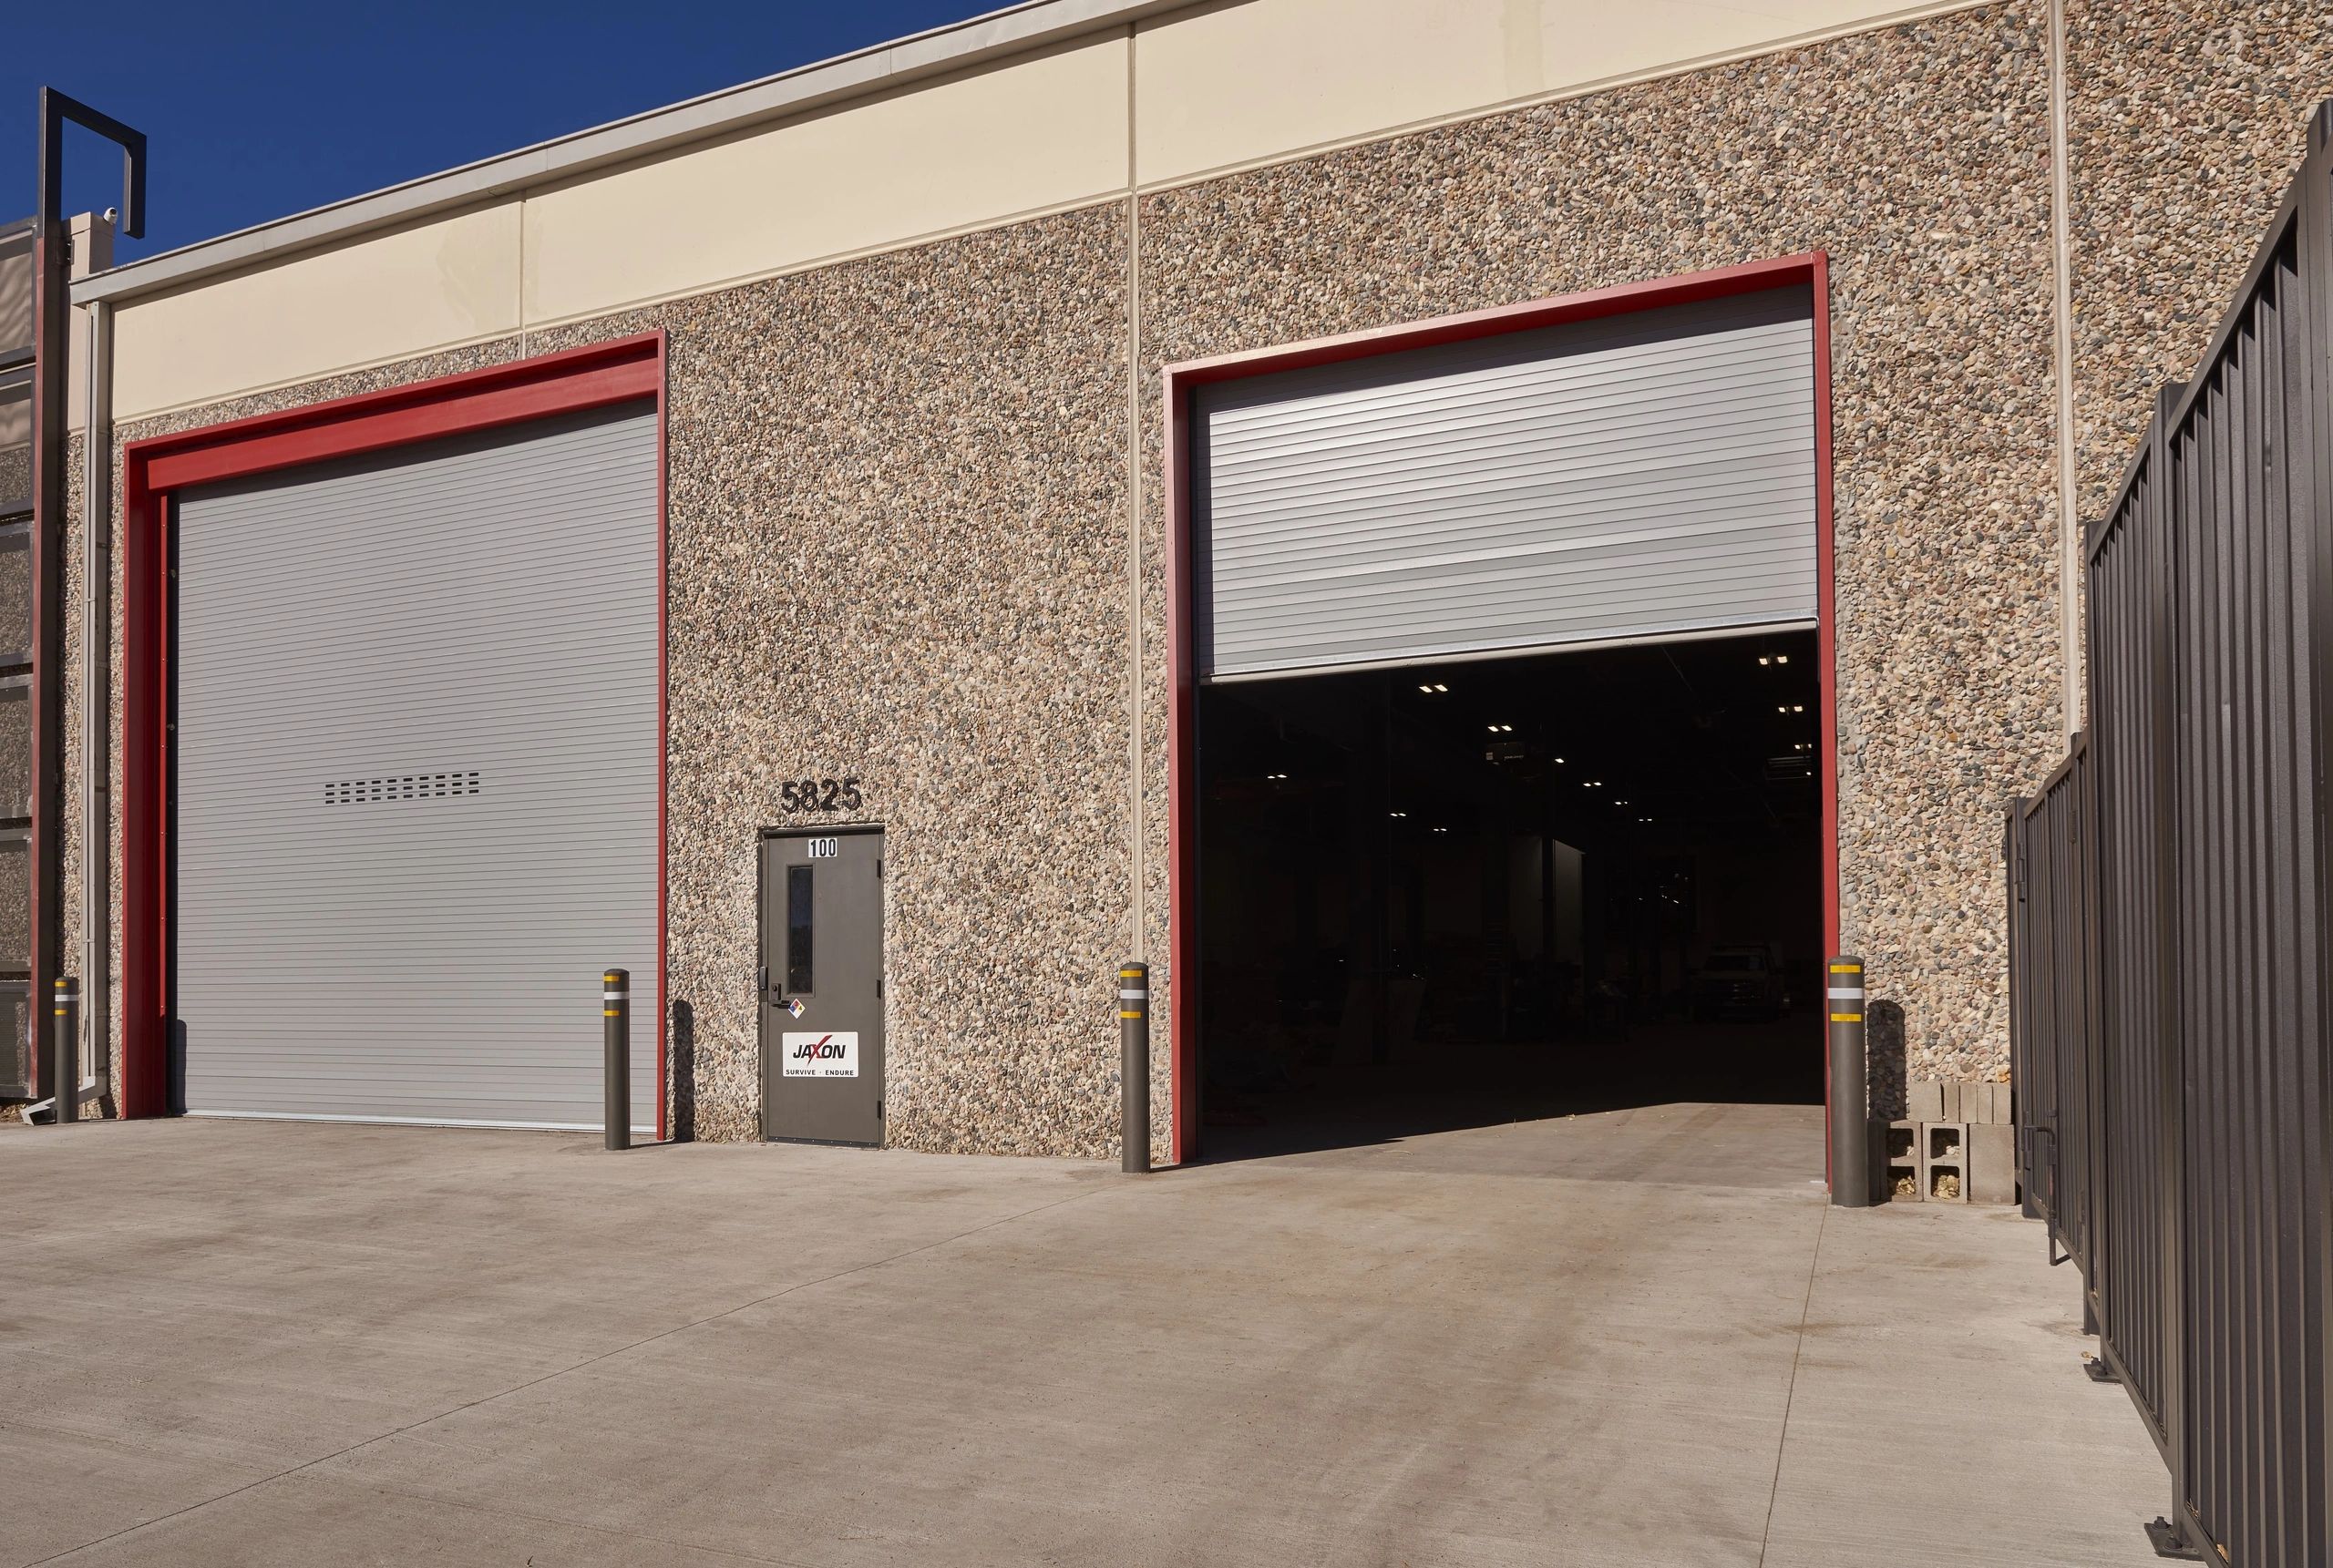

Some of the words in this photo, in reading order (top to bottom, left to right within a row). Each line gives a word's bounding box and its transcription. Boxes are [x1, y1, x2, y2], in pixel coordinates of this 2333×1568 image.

[781, 777, 862, 814] 5825
[810, 838, 837, 857] 100
[792, 1034, 847, 1066] JAXON
